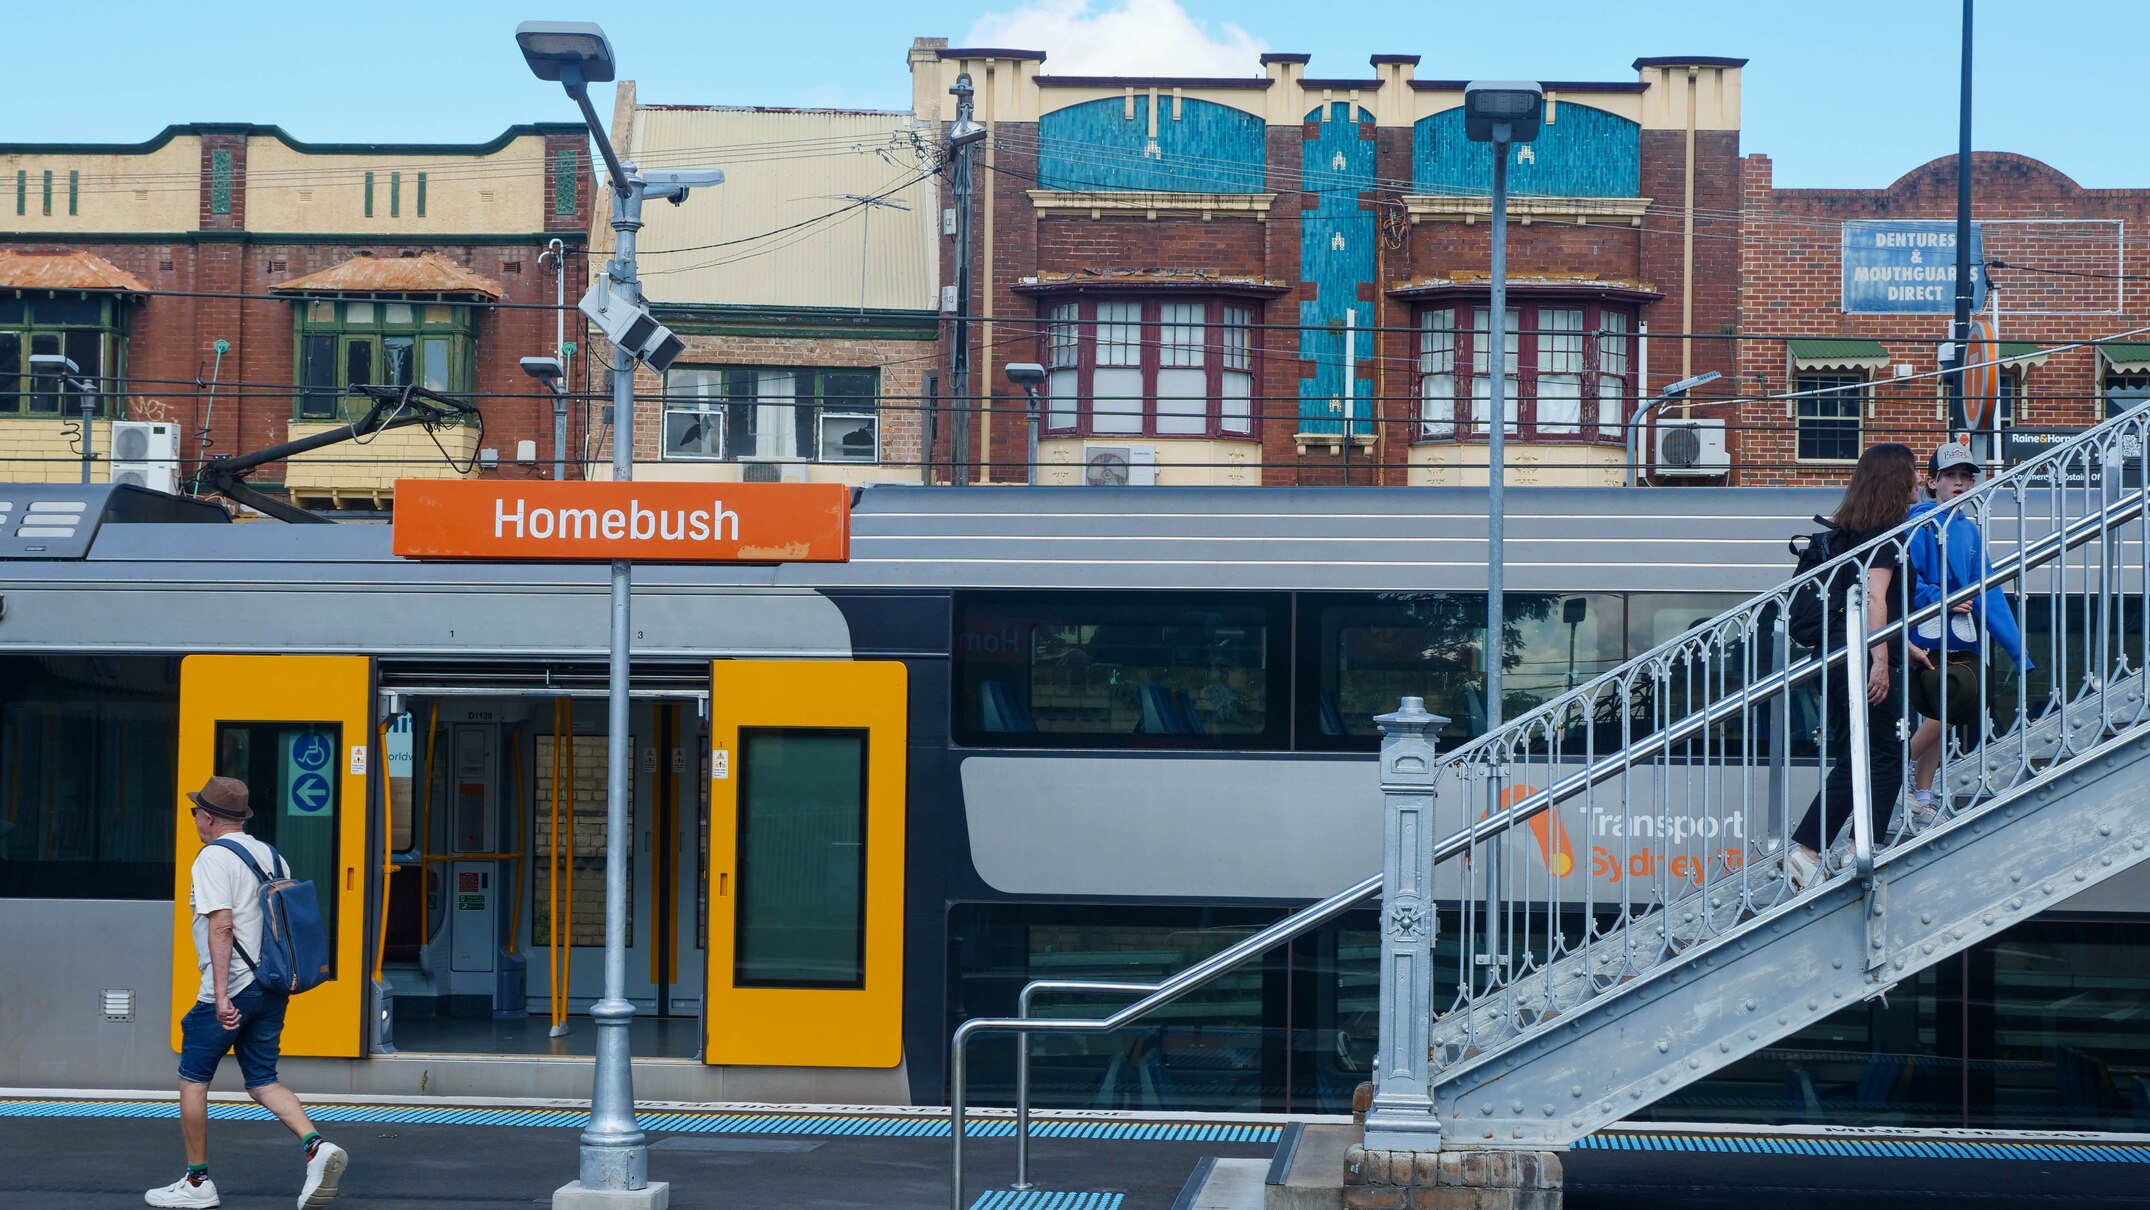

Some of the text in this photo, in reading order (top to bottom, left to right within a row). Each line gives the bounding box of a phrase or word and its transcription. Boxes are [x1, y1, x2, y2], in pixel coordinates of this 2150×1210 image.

[1875, 232, 1956, 247] DENTURES
[1910, 249, 1923, 264] &
[1854, 266, 1978, 281] MOUTHGUARS
[1887, 286, 1943, 301] DIRECT
[2012, 434, 2075, 443] Raine&Horn
[494, 498, 739, 541] Homebush
[449, 630, 454, 638] 1
[637, 631, 644, 639] 3
[1579, 807, 1745, 845] Transport
